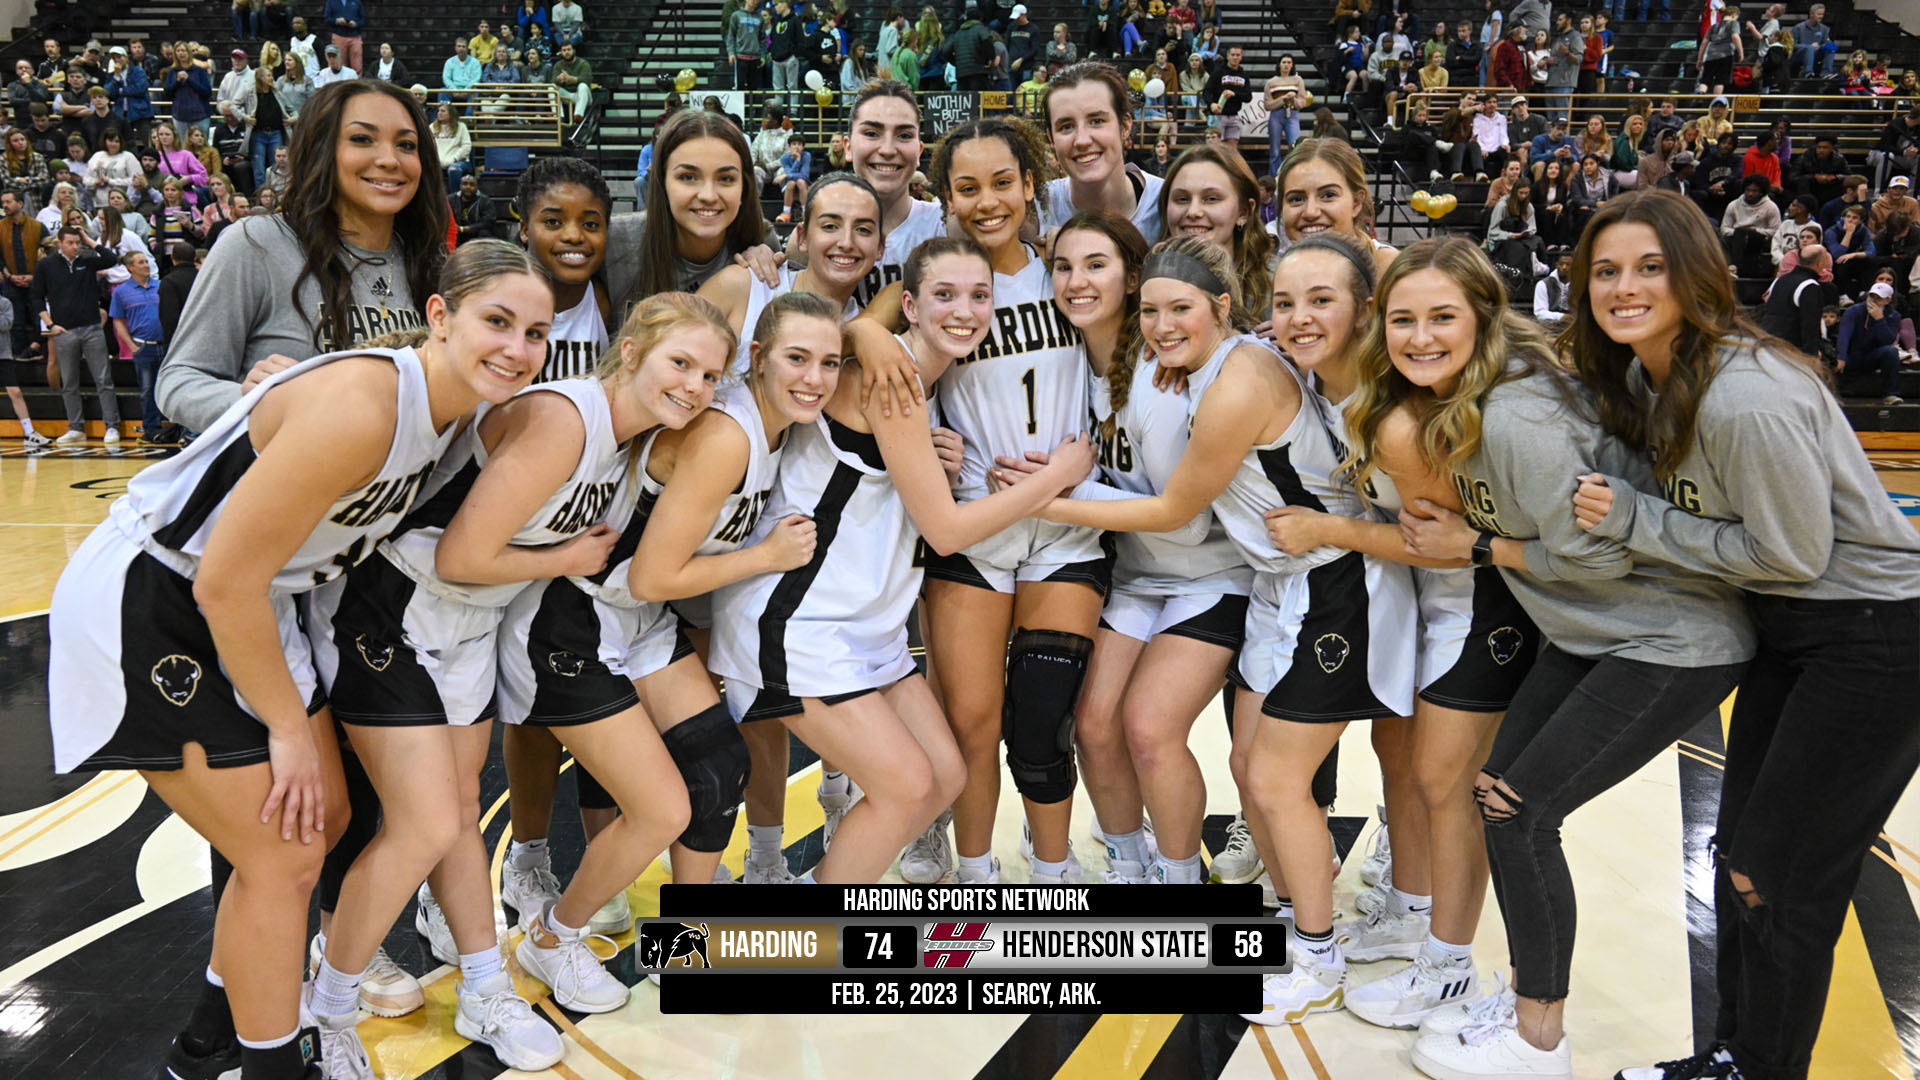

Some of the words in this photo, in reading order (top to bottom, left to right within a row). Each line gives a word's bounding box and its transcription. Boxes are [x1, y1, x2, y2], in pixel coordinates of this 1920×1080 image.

[927, 94, 972, 110] NOTHIN
[983, 93, 1006, 106] HOME
[1021, 366, 1038, 436] 1
